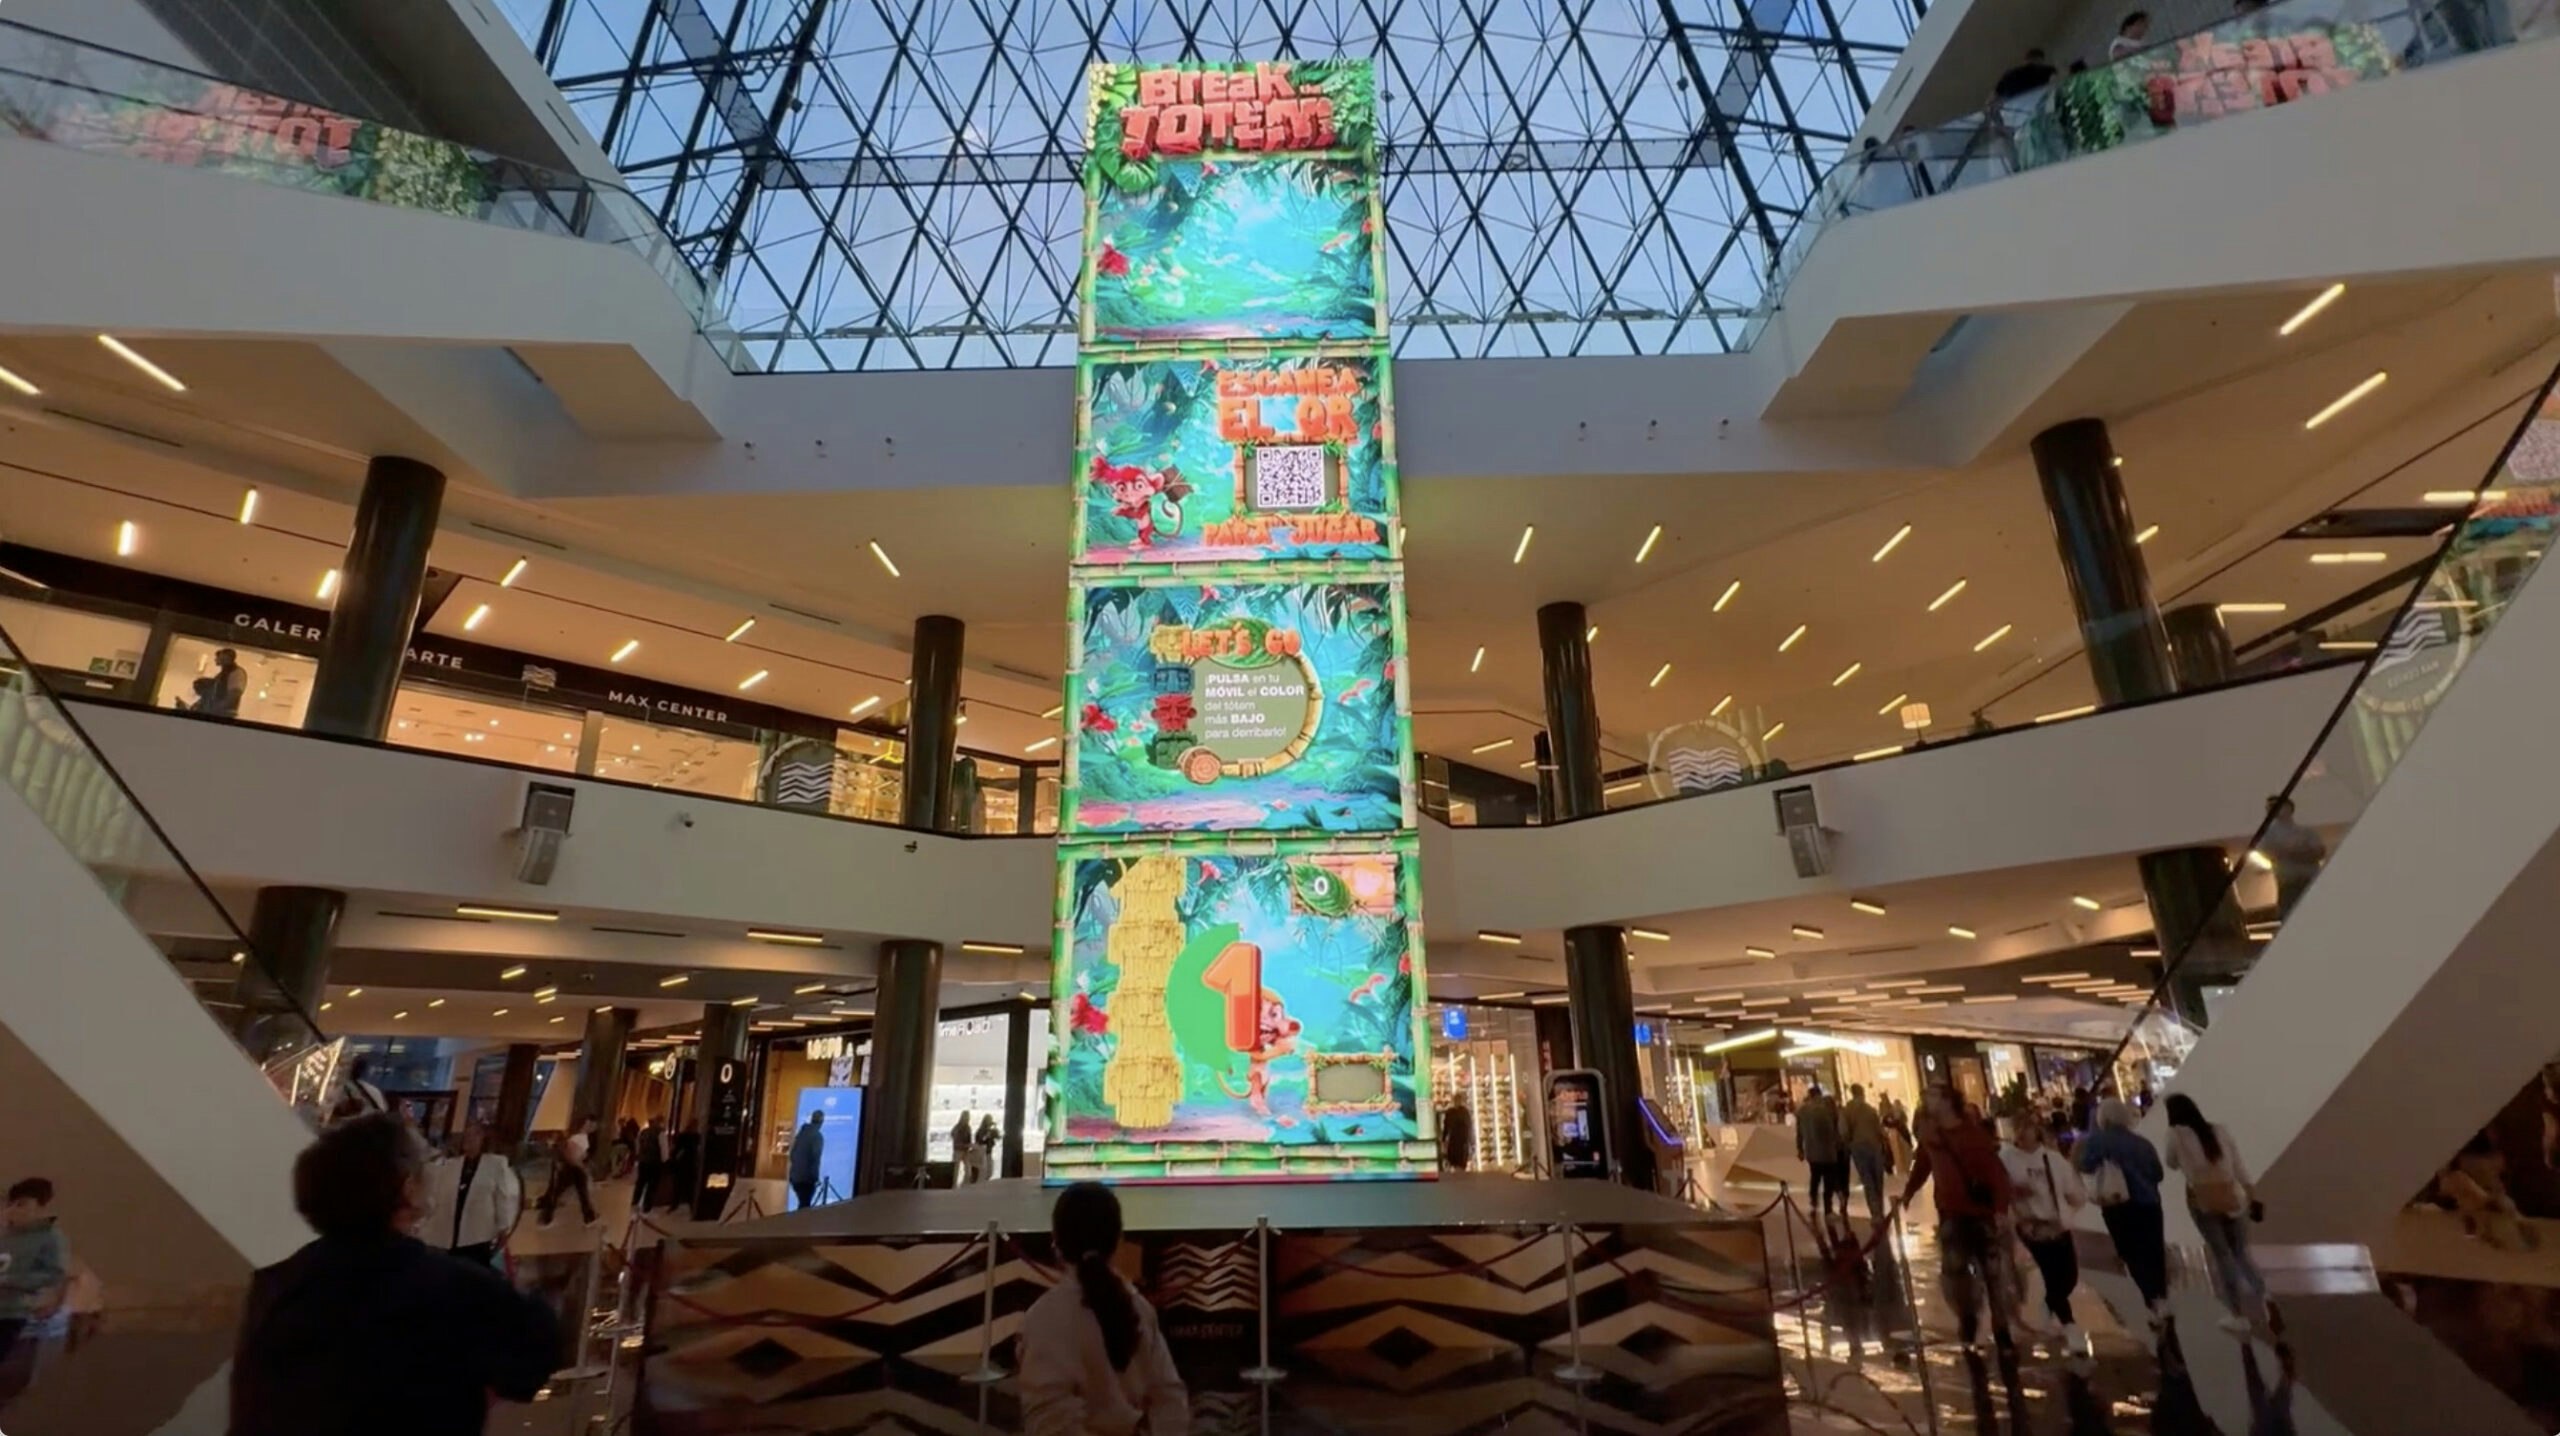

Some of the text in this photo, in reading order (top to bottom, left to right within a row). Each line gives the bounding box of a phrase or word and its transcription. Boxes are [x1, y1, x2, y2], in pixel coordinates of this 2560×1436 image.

[1120, 97, 1335, 159] TOTEM
[1217, 367, 1359, 397] ESCANEA
[1220, 396, 1358, 443] EL QR
[234, 613, 463, 669] GALER ARTE
[1265, 628, 1300, 655] GO
[1205, 685, 1304, 697] MÓVIL el COLOR
[1253, 675, 1266, 683] en
[1269, 674, 1280, 683] tu
[608, 690, 728, 723] MAX CENTER
[1204, 701, 1221, 711] del
[1231, 713, 1265, 724] BAJO
[1205, 729, 1229, 739] para
[1202, 941, 1262, 1052] 1
